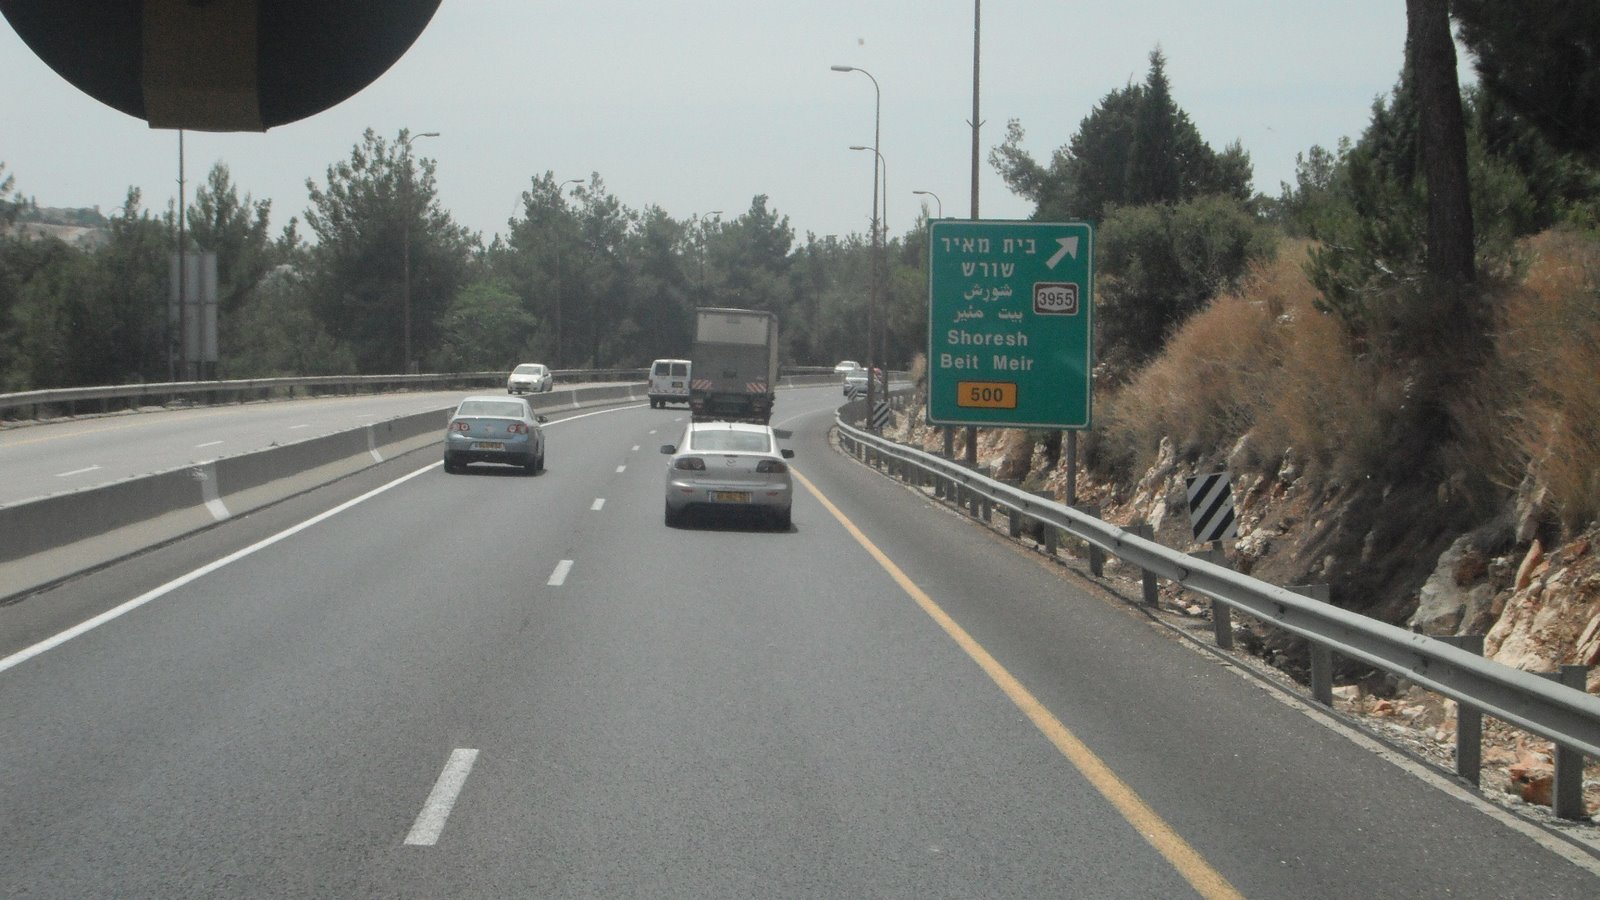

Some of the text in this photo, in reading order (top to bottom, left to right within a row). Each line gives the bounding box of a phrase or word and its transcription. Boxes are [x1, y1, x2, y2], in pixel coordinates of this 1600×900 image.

[941, 237, 1035, 254] בית מאיר
[962, 262, 1014, 277] שורש
[964, 283, 1012, 302] شورش
[1039, 292, 1072, 306] 3955
[999, 307, 1024, 323] بيت
[948, 330, 1028, 346] Shoresh
[941, 354, 1034, 370] Beit Meir
[971, 388, 1003, 402] 500
